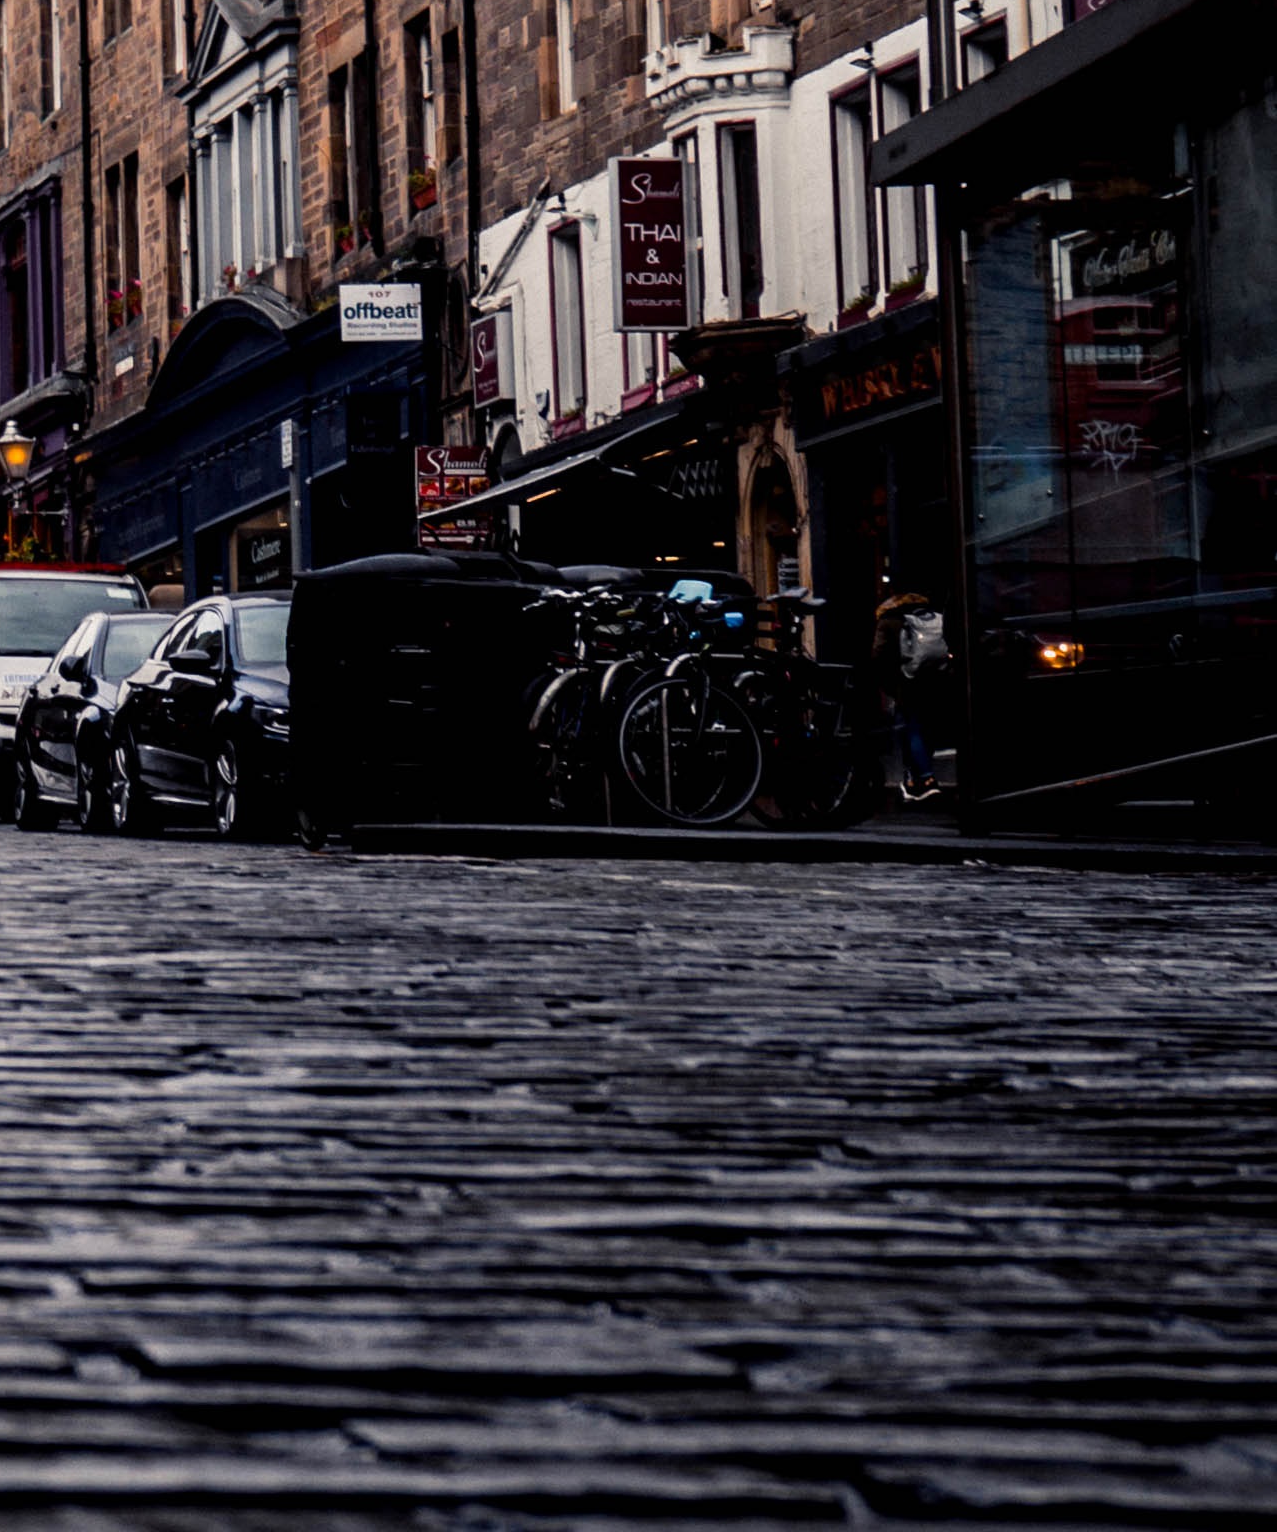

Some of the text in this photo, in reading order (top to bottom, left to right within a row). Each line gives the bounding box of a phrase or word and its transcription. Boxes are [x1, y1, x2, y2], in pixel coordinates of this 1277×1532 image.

[623, 223, 682, 243] THAI
[645, 248, 661, 265] &
[625, 272, 683, 286] INDIAN
[367, 291, 391, 299] 107
[625, 298, 683, 308] restaurant
[418, 447, 488, 476] Shamoli
